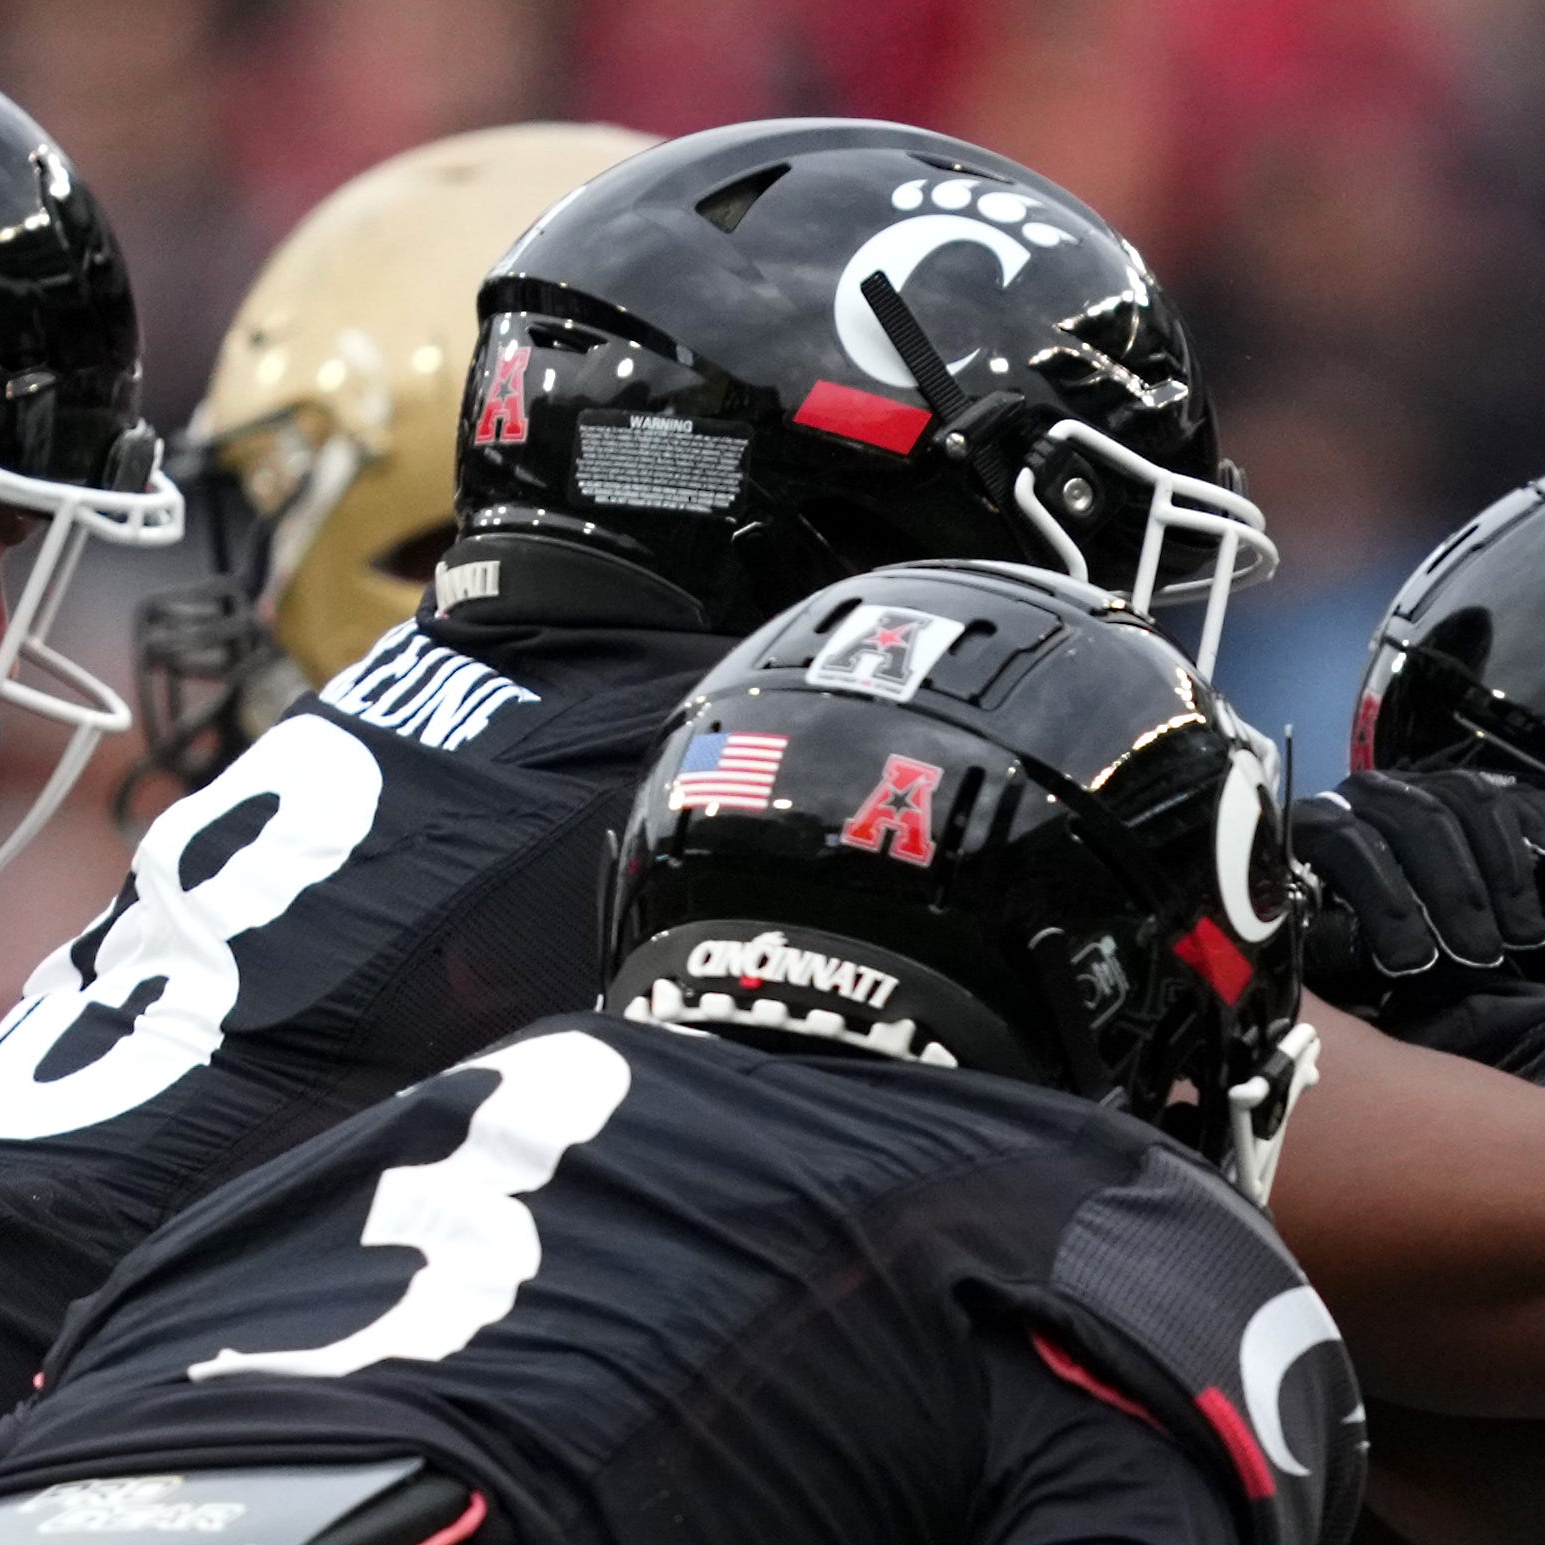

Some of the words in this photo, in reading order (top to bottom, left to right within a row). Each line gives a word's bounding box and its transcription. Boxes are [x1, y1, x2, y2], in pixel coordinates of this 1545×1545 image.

[629, 415, 694, 434] WARNING
[840, 753, 945, 868] A
[686, 930, 900, 1010] CINCINNATI
[187, 1030, 632, 1383] 3
